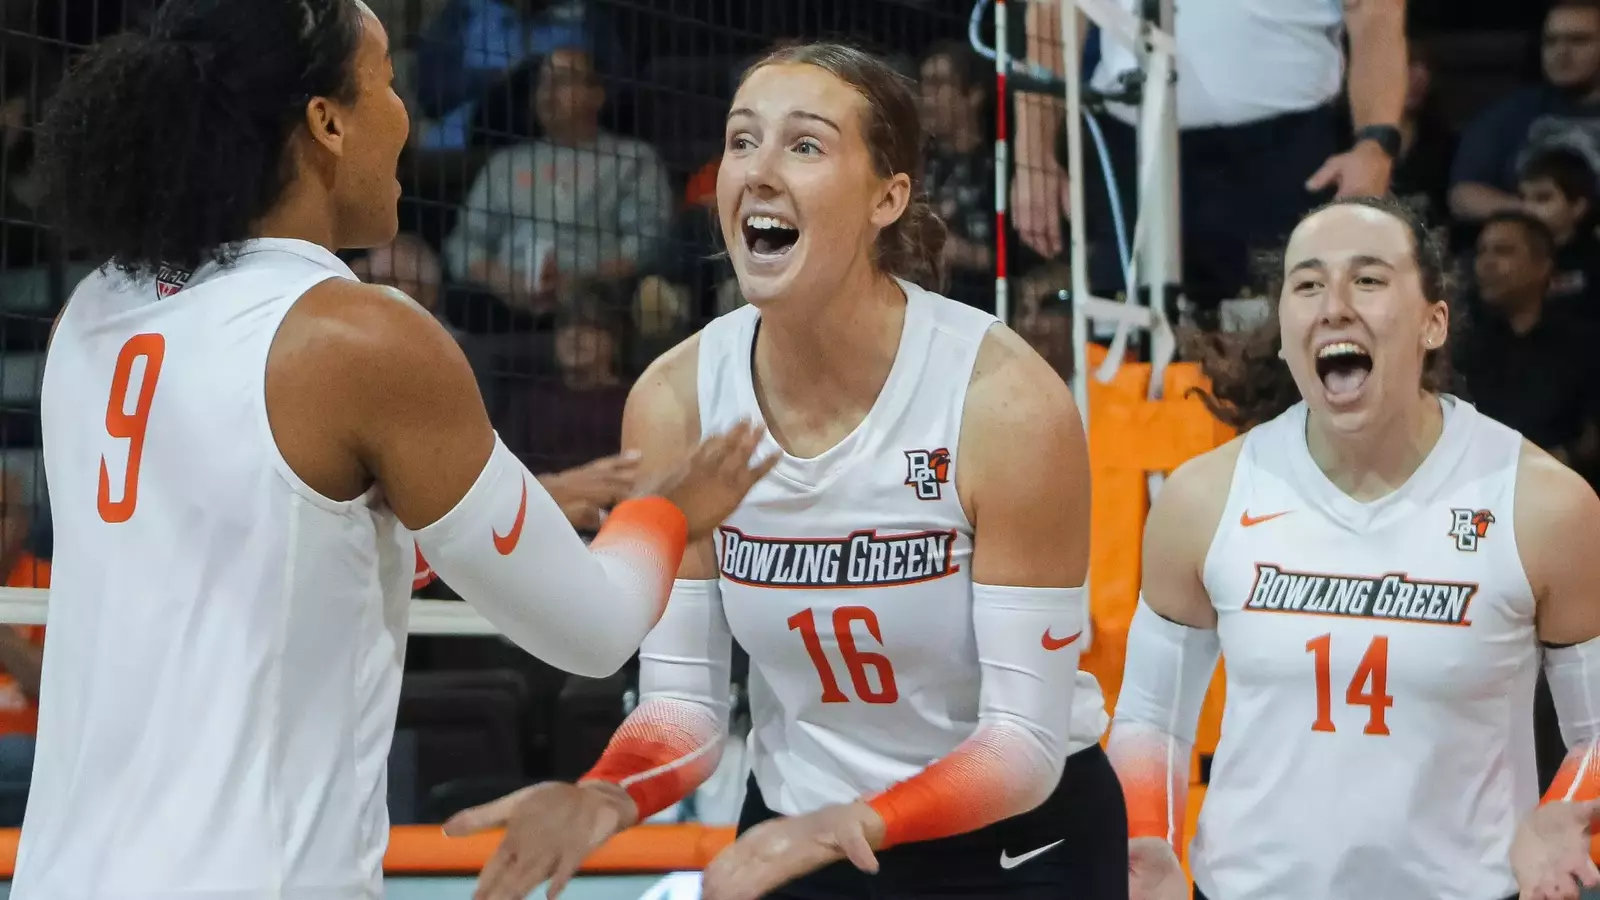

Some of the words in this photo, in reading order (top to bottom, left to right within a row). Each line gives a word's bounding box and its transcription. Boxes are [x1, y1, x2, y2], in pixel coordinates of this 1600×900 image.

[97, 332, 166, 524] 9
[904, 449, 941, 500] BG
[721, 530, 842, 584] BOWLING
[846, 534, 950, 583] GREEN
[1448, 508, 1478, 552] BG
[1249, 565, 1374, 616] BOWLING
[1372, 575, 1473, 622] GREEN
[787, 605, 899, 704] 16
[1305, 632, 1394, 736] 14
